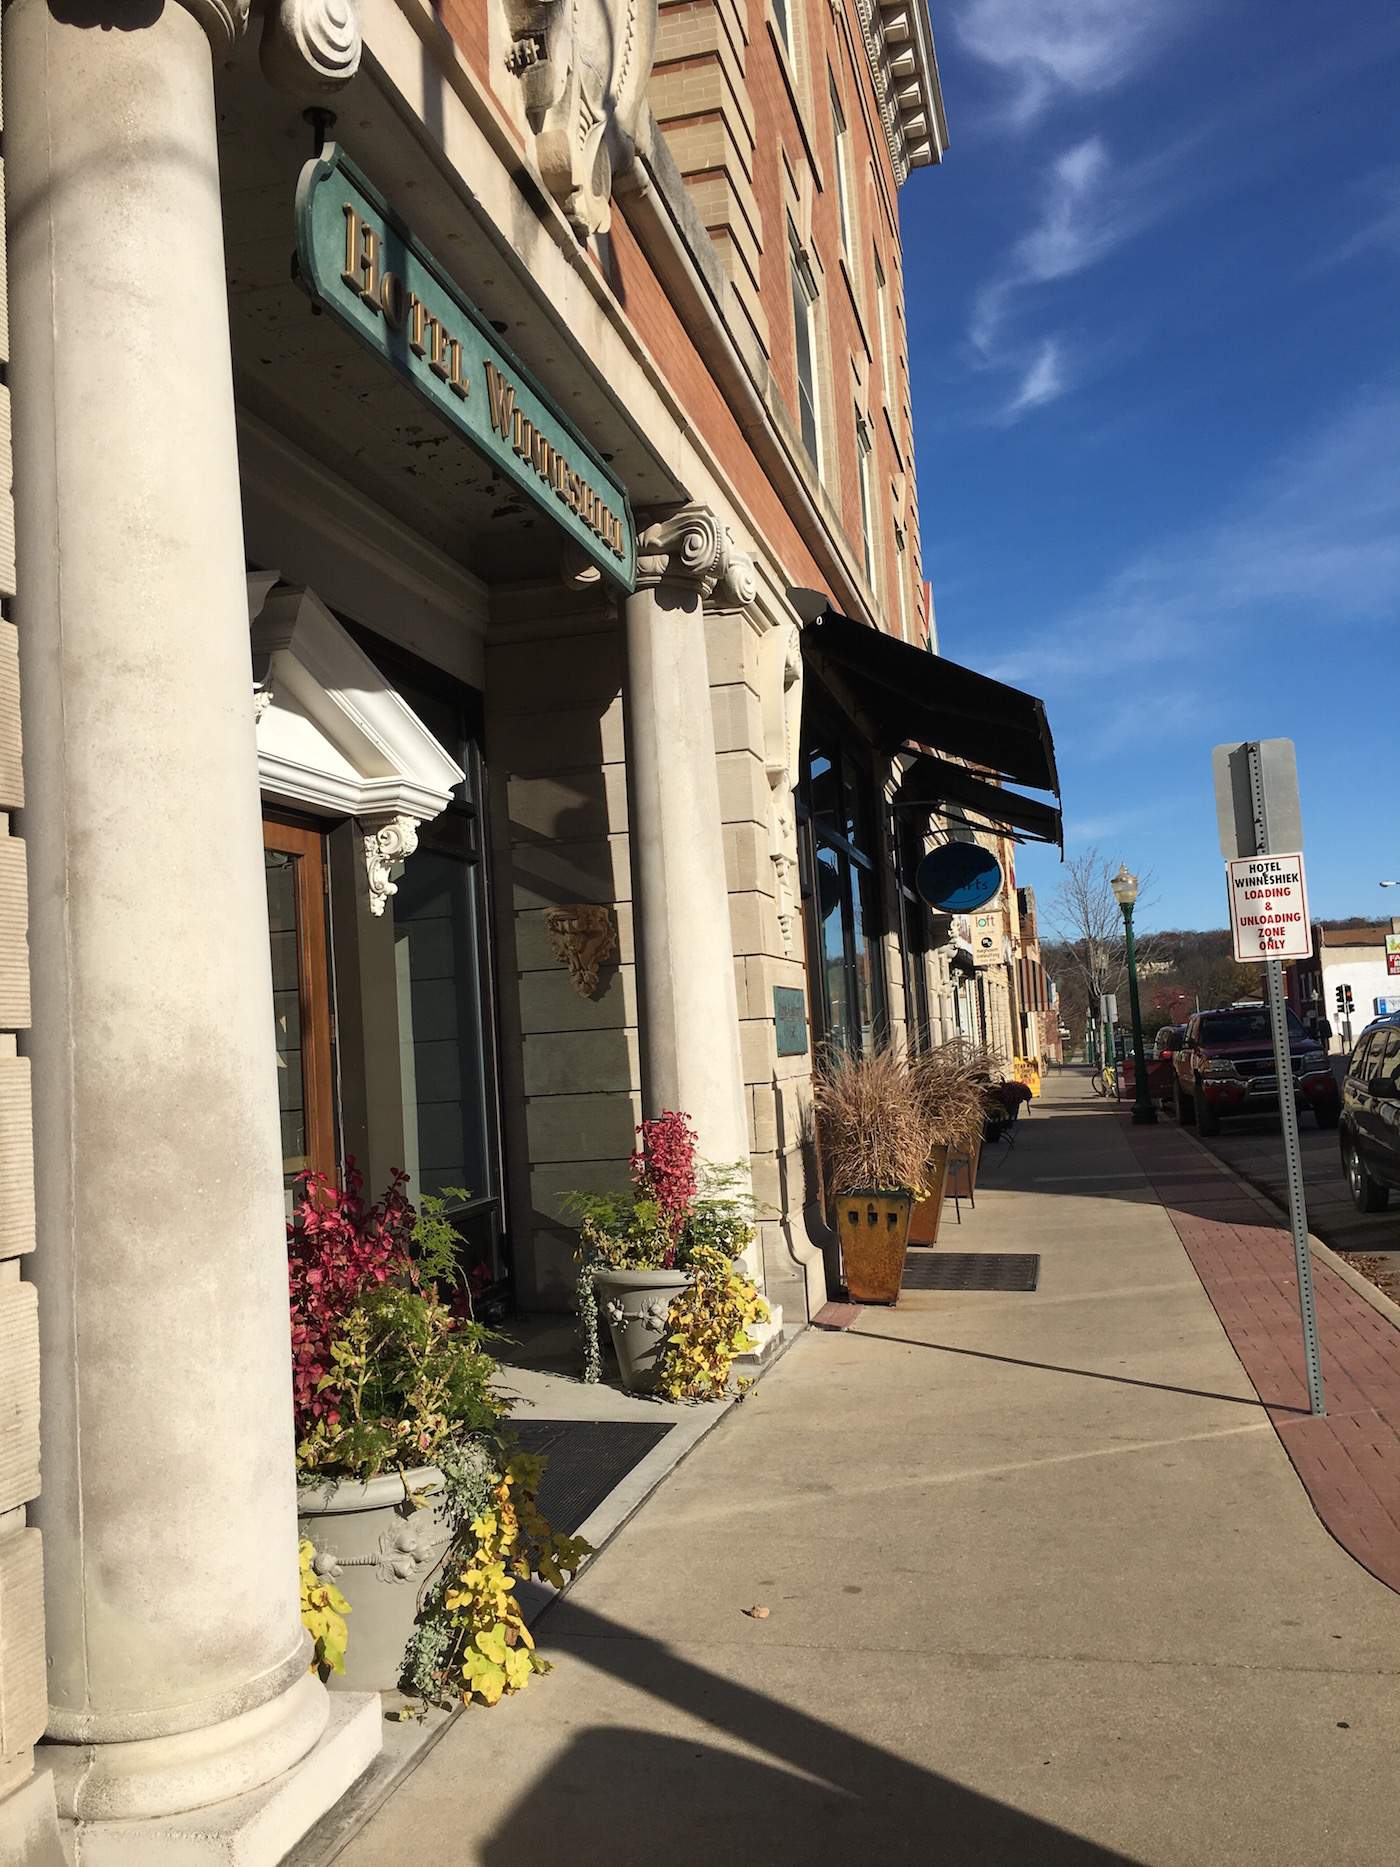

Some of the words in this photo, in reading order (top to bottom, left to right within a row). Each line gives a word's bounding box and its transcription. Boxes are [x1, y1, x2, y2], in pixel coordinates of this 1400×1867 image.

[1249, 862, 1281, 874] HOTEL
[1235, 873, 1299, 888] WINNESHIEK
[1244, 887, 1291, 900] LOADING
[1264, 902, 1273, 911] &
[975, 914, 995, 928] loft
[1240, 912, 1301, 926] UNLOADING
[1257, 926, 1286, 938] ZONE
[1258, 940, 1285, 951] ONLY
